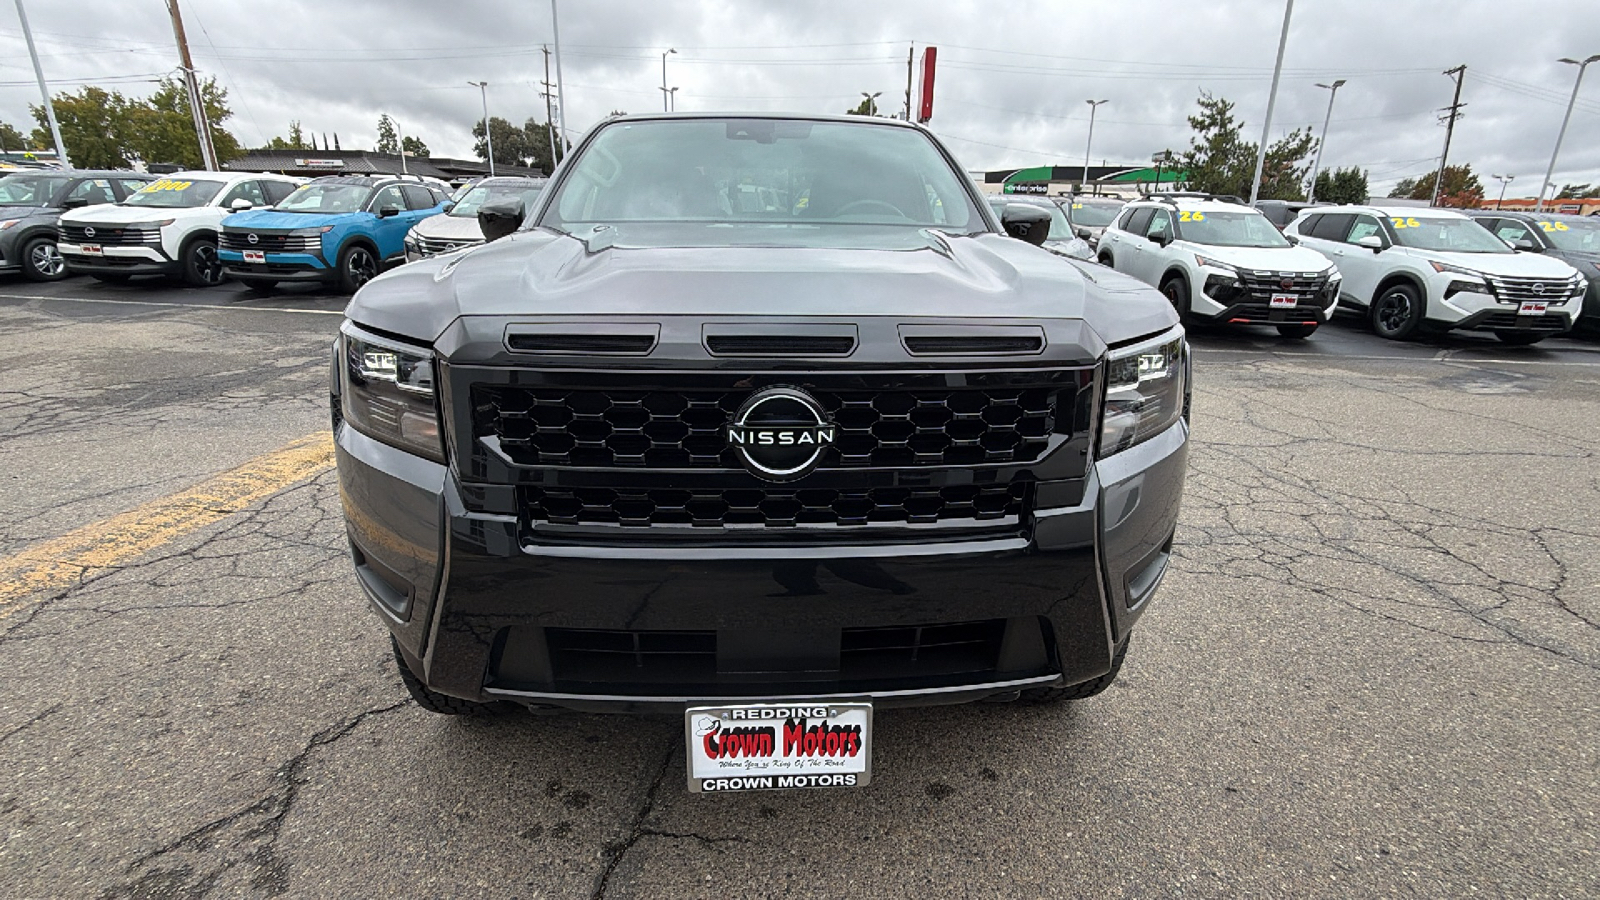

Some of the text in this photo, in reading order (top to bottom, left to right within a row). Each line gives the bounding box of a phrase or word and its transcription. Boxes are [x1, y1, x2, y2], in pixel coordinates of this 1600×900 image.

[1005, 184, 1047, 193] enterprise
[1179, 211, 1204, 222] 26
[1391, 217, 1420, 228] 26
[1538, 221, 1569, 232] 26
[729, 429, 833, 445] NISSAN
[732, 708, 827, 720] REDDING
[703, 718, 862, 760] Crown Motors
[772, 760, 791, 768] King
[807, 759, 821, 767] The
[823, 759, 845, 767] Road
[702, 774, 857, 791] CROWN MOTORS
